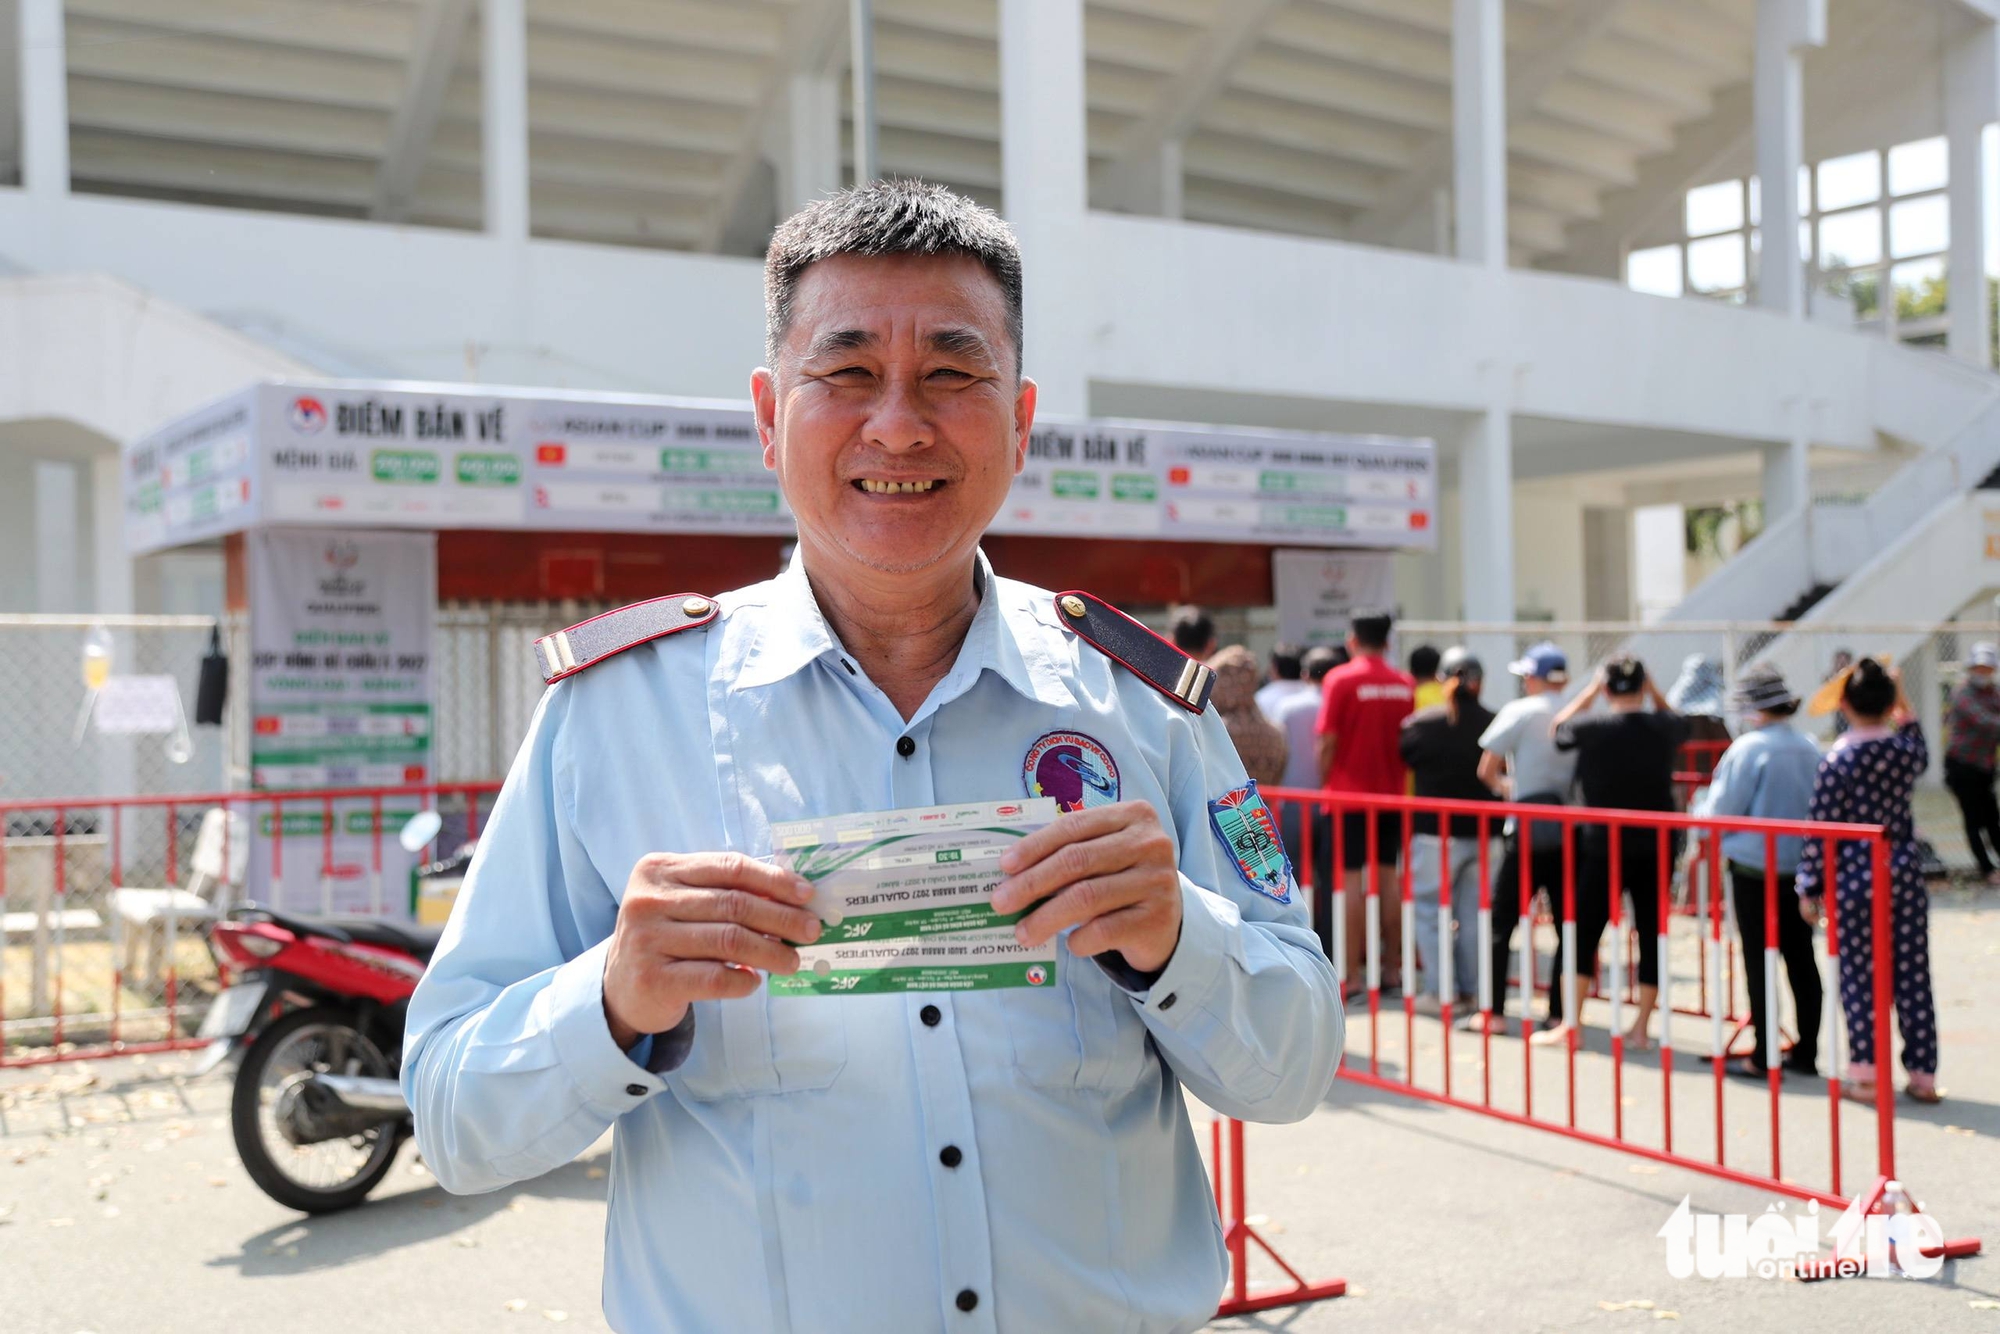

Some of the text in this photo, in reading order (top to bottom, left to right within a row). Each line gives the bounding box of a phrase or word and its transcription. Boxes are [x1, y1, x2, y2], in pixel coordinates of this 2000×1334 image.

[416, 403, 465, 440] BÁN
[476, 405, 505, 443] VÉ
[937, 851, 959, 861] 19:30
[904, 878, 922, 886] 2027
[912, 889, 930, 899] 2027
[932, 887, 956, 897] ARABIA
[958, 885, 978, 894] SAUDI
[846, 891, 910, 906] QUALIFIERS
[843, 922, 873, 938] AFC
[835, 944, 1029, 959] ASIAN CUP SAUDI ARABIA 2027 QUALIFIERS
[831, 976, 861, 990] AFC
